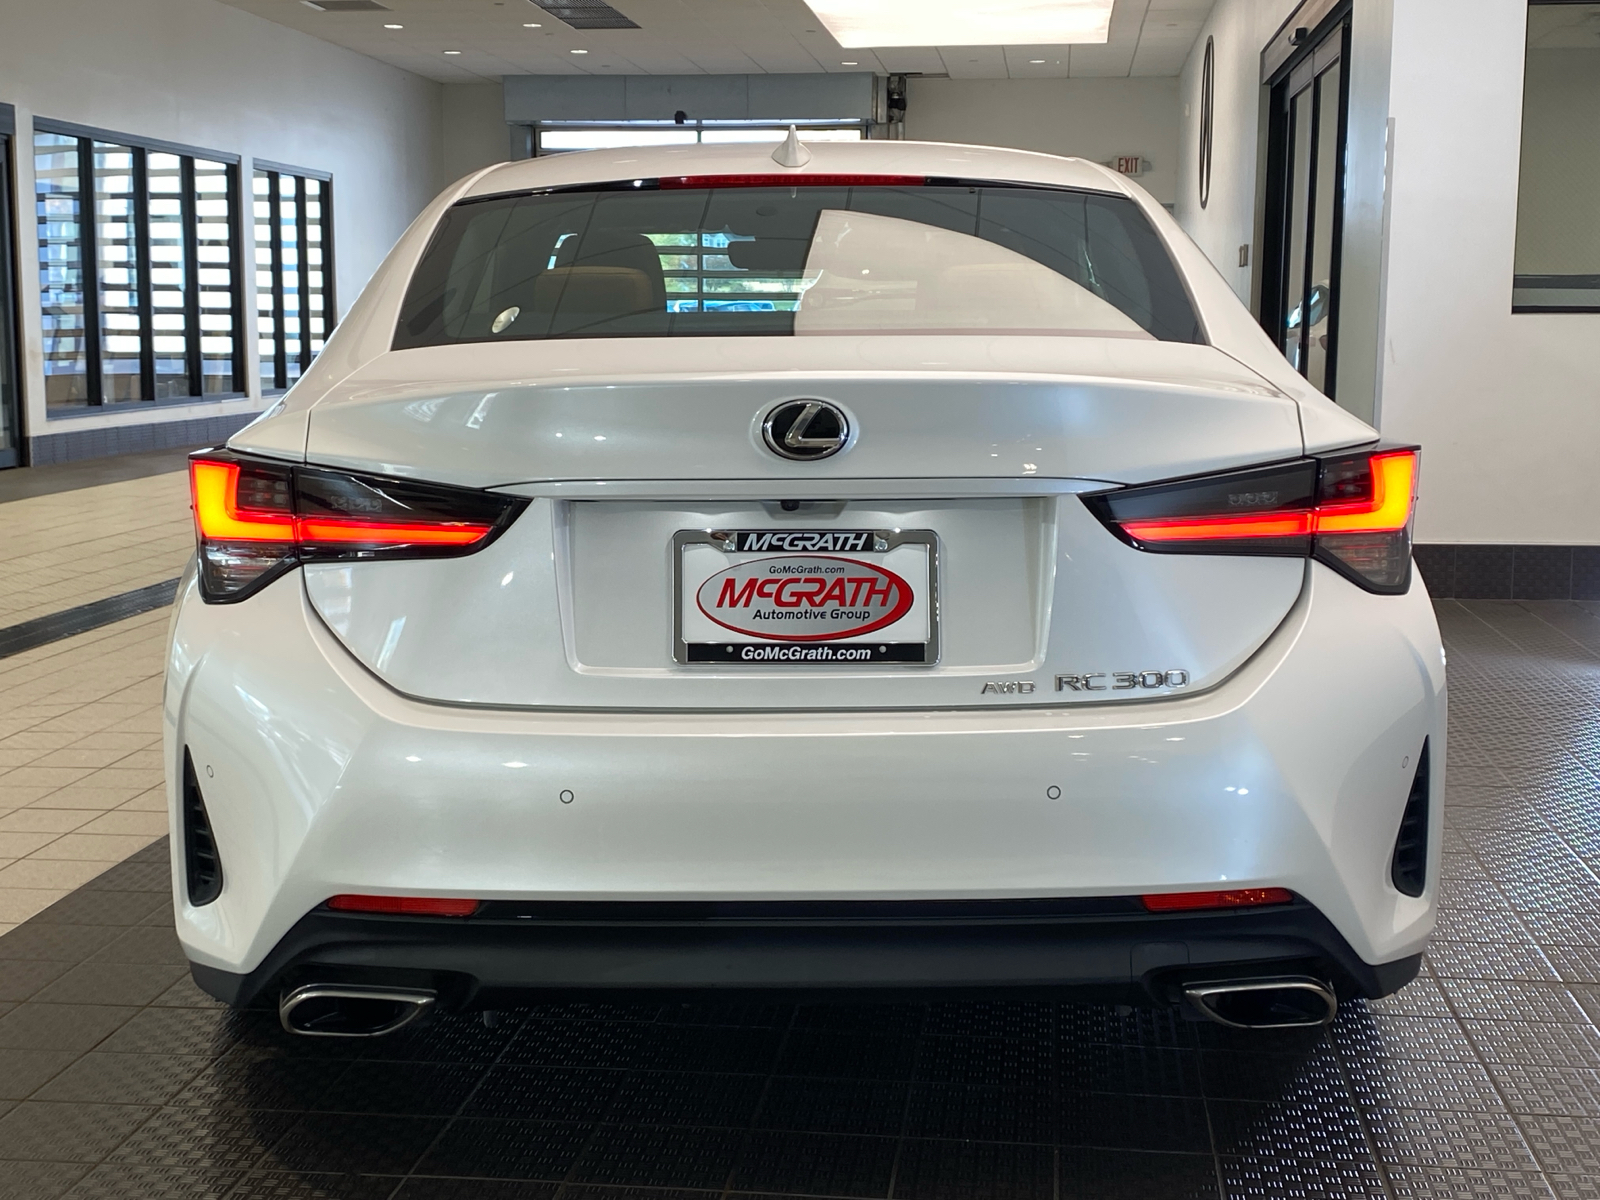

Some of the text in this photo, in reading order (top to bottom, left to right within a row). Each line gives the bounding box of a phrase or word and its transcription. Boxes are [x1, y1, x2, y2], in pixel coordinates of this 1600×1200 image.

[1117, 157, 1139, 174] EXIT
[768, 565, 845, 575] GoMcGrath.com
[752, 608, 871, 621] Automotive Group
[741, 647, 872, 661] GoMcGrath.com
[1055, 669, 1190, 692] RC 300
[981, 681, 1037, 695] AWD
